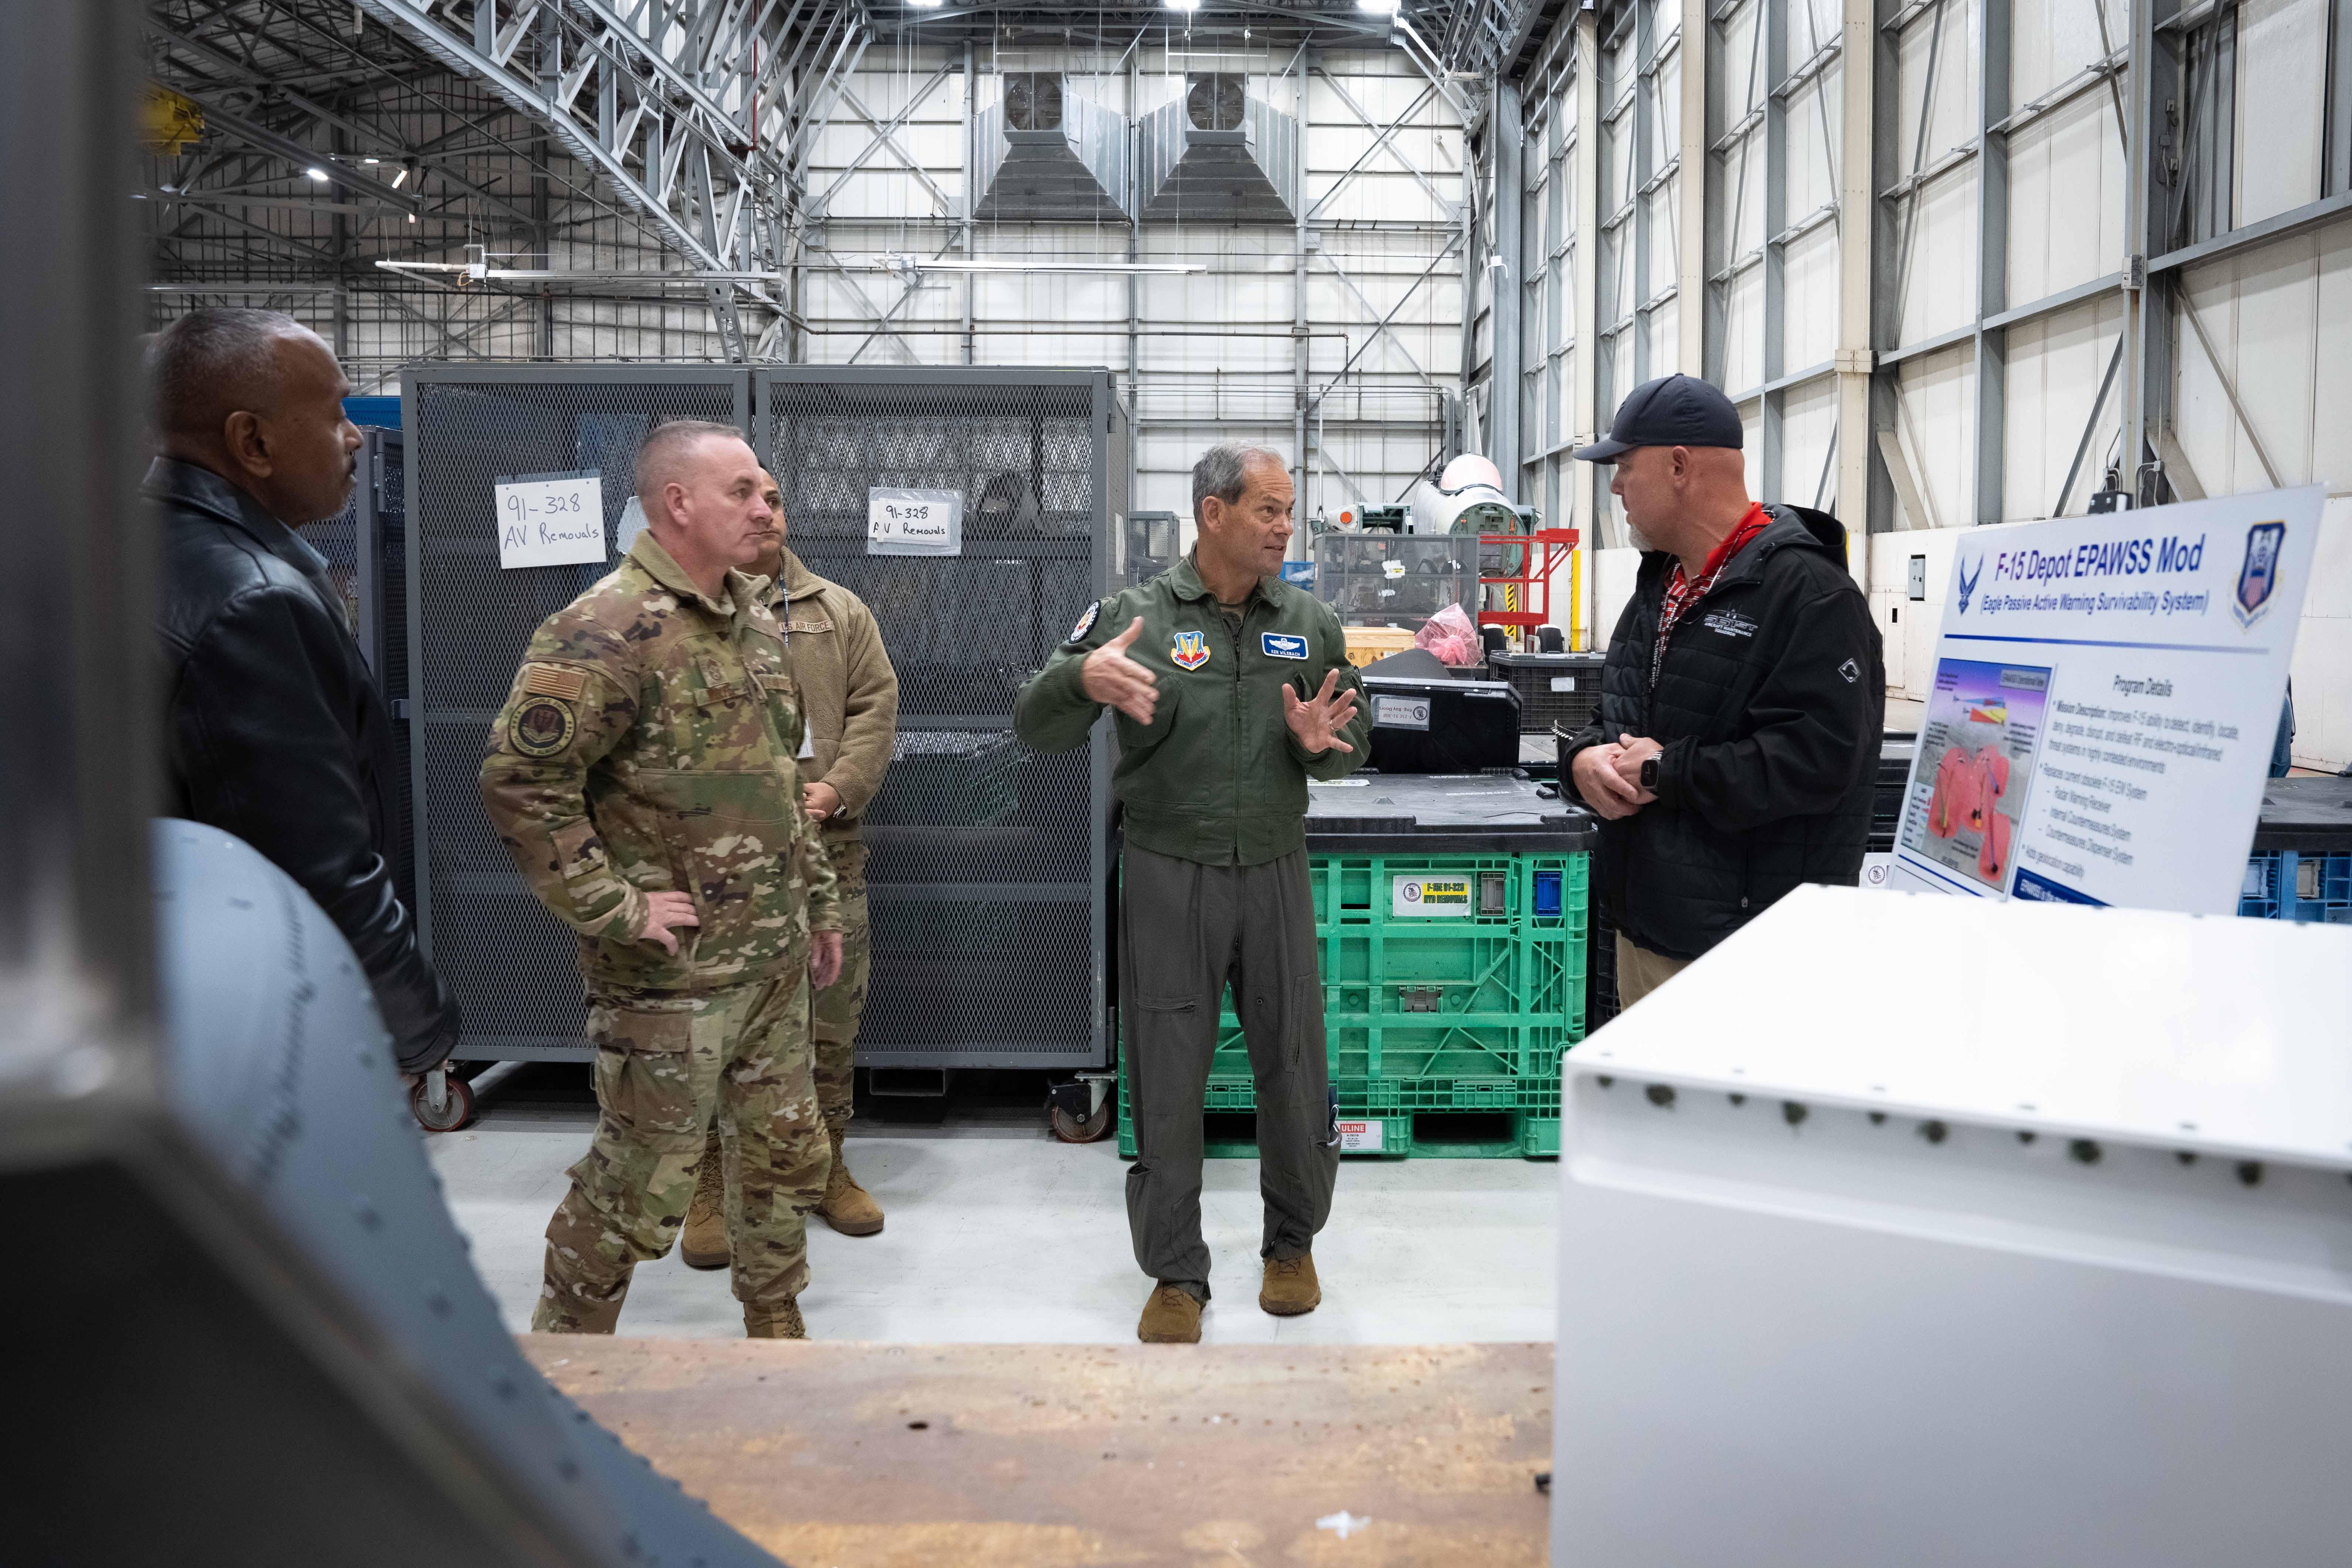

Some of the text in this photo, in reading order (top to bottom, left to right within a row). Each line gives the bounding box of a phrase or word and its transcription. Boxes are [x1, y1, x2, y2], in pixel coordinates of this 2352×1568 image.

[886, 505, 928, 519] 91-328
[504, 522, 599, 549] AV Removals
[903, 522, 945, 535] Removals
[1996, 533, 2205, 586] F-15 Depot EPAWSS Mod
[1980, 593, 2002, 615] (Eagle
[2003, 595, 2032, 610] Passive
[2032, 594, 2058, 610] Active
[2060, 593, 2095, 615] Warning
[2097, 592, 2160, 615] Survivability
[2162, 589, 2210, 616] System)
[807, 622, 829, 631] FORCE
[1194, 654, 1207, 666] COMMAND
[2112, 675, 2173, 697] Program Details
[1437, 895, 1468, 903] REMOVALS
